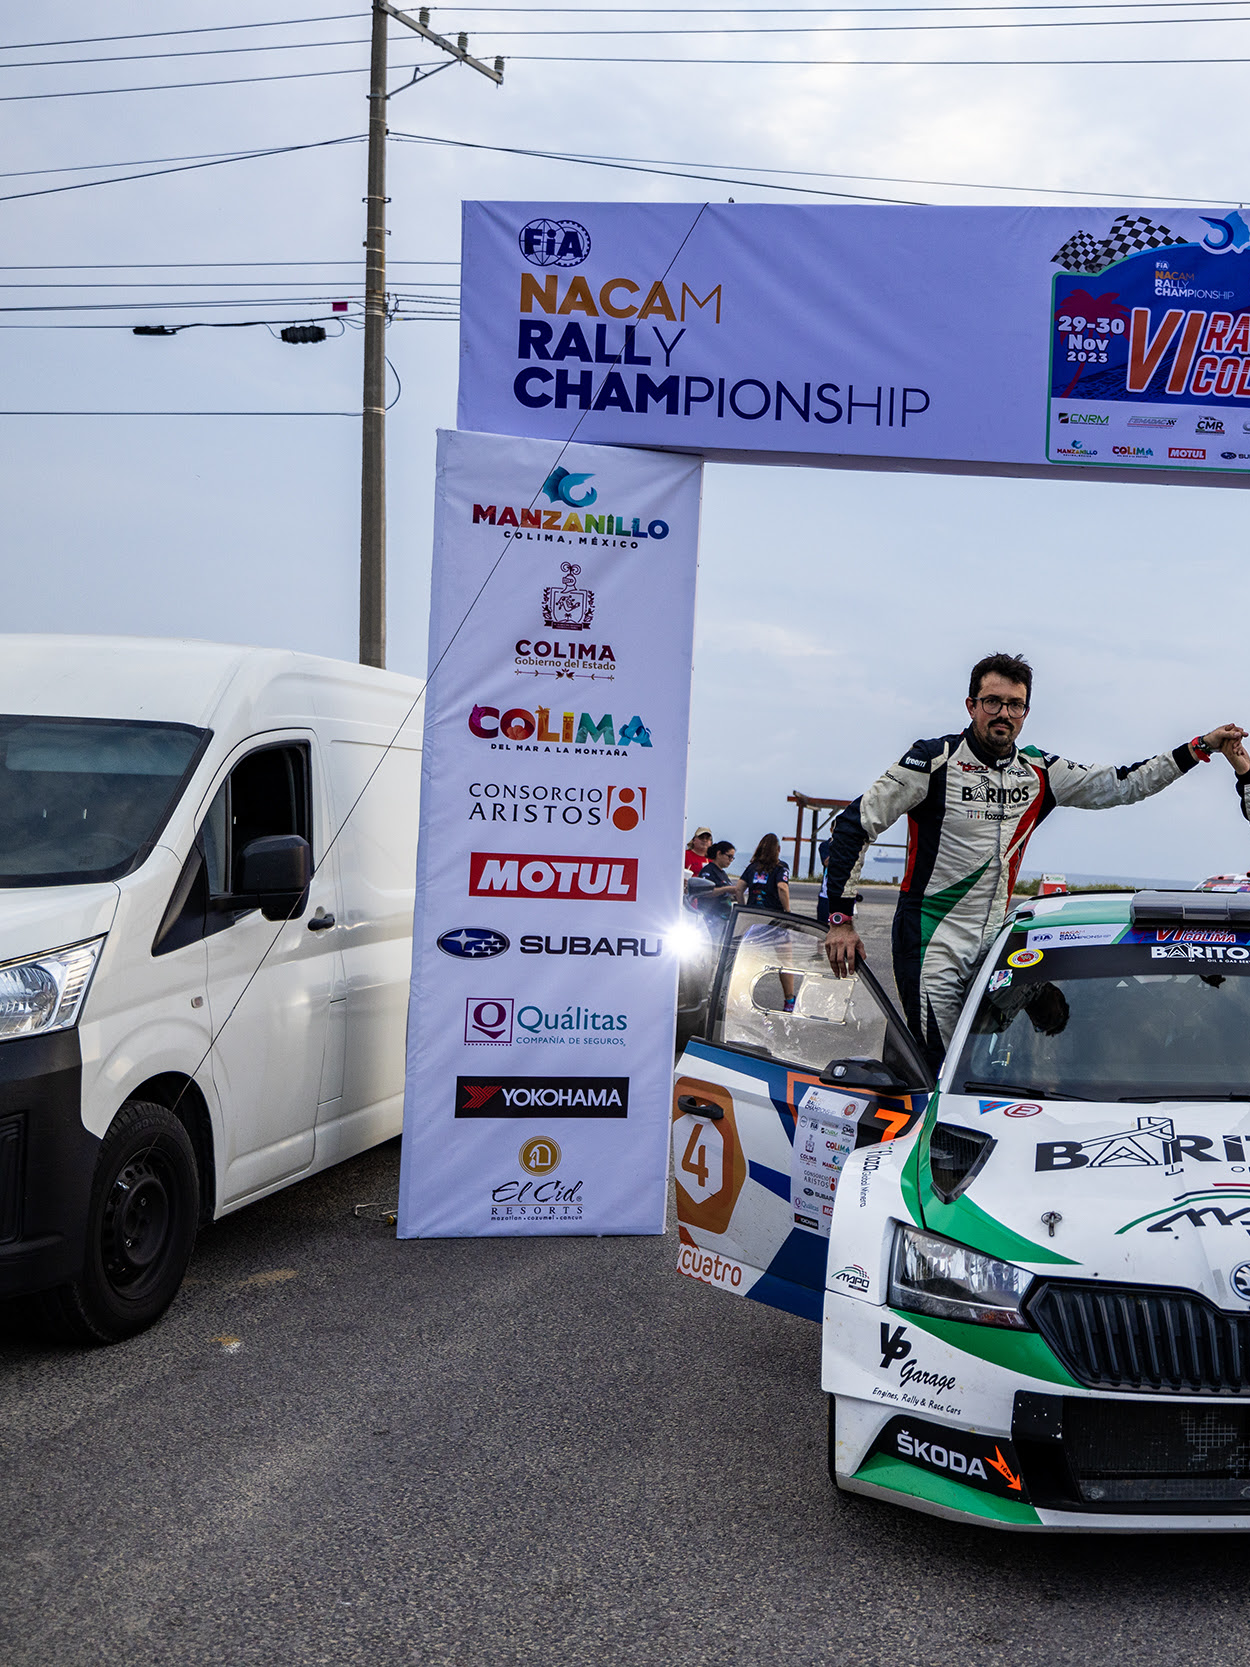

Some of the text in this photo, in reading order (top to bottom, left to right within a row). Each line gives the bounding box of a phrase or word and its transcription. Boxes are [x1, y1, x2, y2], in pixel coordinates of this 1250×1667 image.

[1155, 271, 1194, 280] NACAM
[1155, 279, 1189, 289] RALLY
[520, 273, 722, 324] NACAM
[1155, 289, 1234, 300] CHAMPIONSHIP
[1058, 315, 1125, 334] 29-30
[517, 320, 686, 367] RALLY
[1068, 334, 1109, 351] Nov
[1127, 307, 1207, 396] VI
[1067, 351, 1108, 364] 2023
[513, 367, 930, 428] CHAMPIONSHIP
[1070, 414, 1109, 424] CNRM
[1197, 421, 1223, 430] CMR
[1057, 448, 1098, 456] MANZANILLO
[1112, 446, 1153, 456] COLIMA
[1170, 449, 1205, 458] MOTUL
[473, 504, 669, 540] MANZANILLO
[504, 530, 638, 549] COLIMA, MÉXICO
[515, 657, 616, 671] Gobierno del Estado
[468, 703, 653, 748] COLIMA
[491, 743, 511, 751] DEL
[516, 744, 539, 752] MAR
[575, 748, 628, 757] MONTAÑA
[469, 783, 603, 803] CONSORCIO
[469, 802, 601, 825] ARISTOS
[477, 860, 630, 895] MOTUL
[1157, 928, 1185, 942] VI
[1183, 933, 1236, 942] COLIMA
[519, 935, 663, 957] SUBARU
[517, 1005, 628, 1034] Quálitas
[516, 1035, 566, 1045] COMPAÑÍA
[569, 1037, 581, 1045] DE
[502, 1088, 622, 1107] YOKOHAMA
[682, 1123, 709, 1187] 4
[491, 1180, 583, 1203] El Cid
[804, 1177, 829, 1188] ARISTOS
[491, 1206, 583, 1215] RESORTS
[900, 1359, 956, 1395] Garage
[872, 1387, 899, 1401] Engines,
[902, 1393, 919, 1406] Rally
[928, 1400, 944, 1411] Race
[945, 1404, 961, 1416] Cars
[897, 1429, 988, 1480] ŠKODA
[999, 1464, 1012, 1479] TOW
